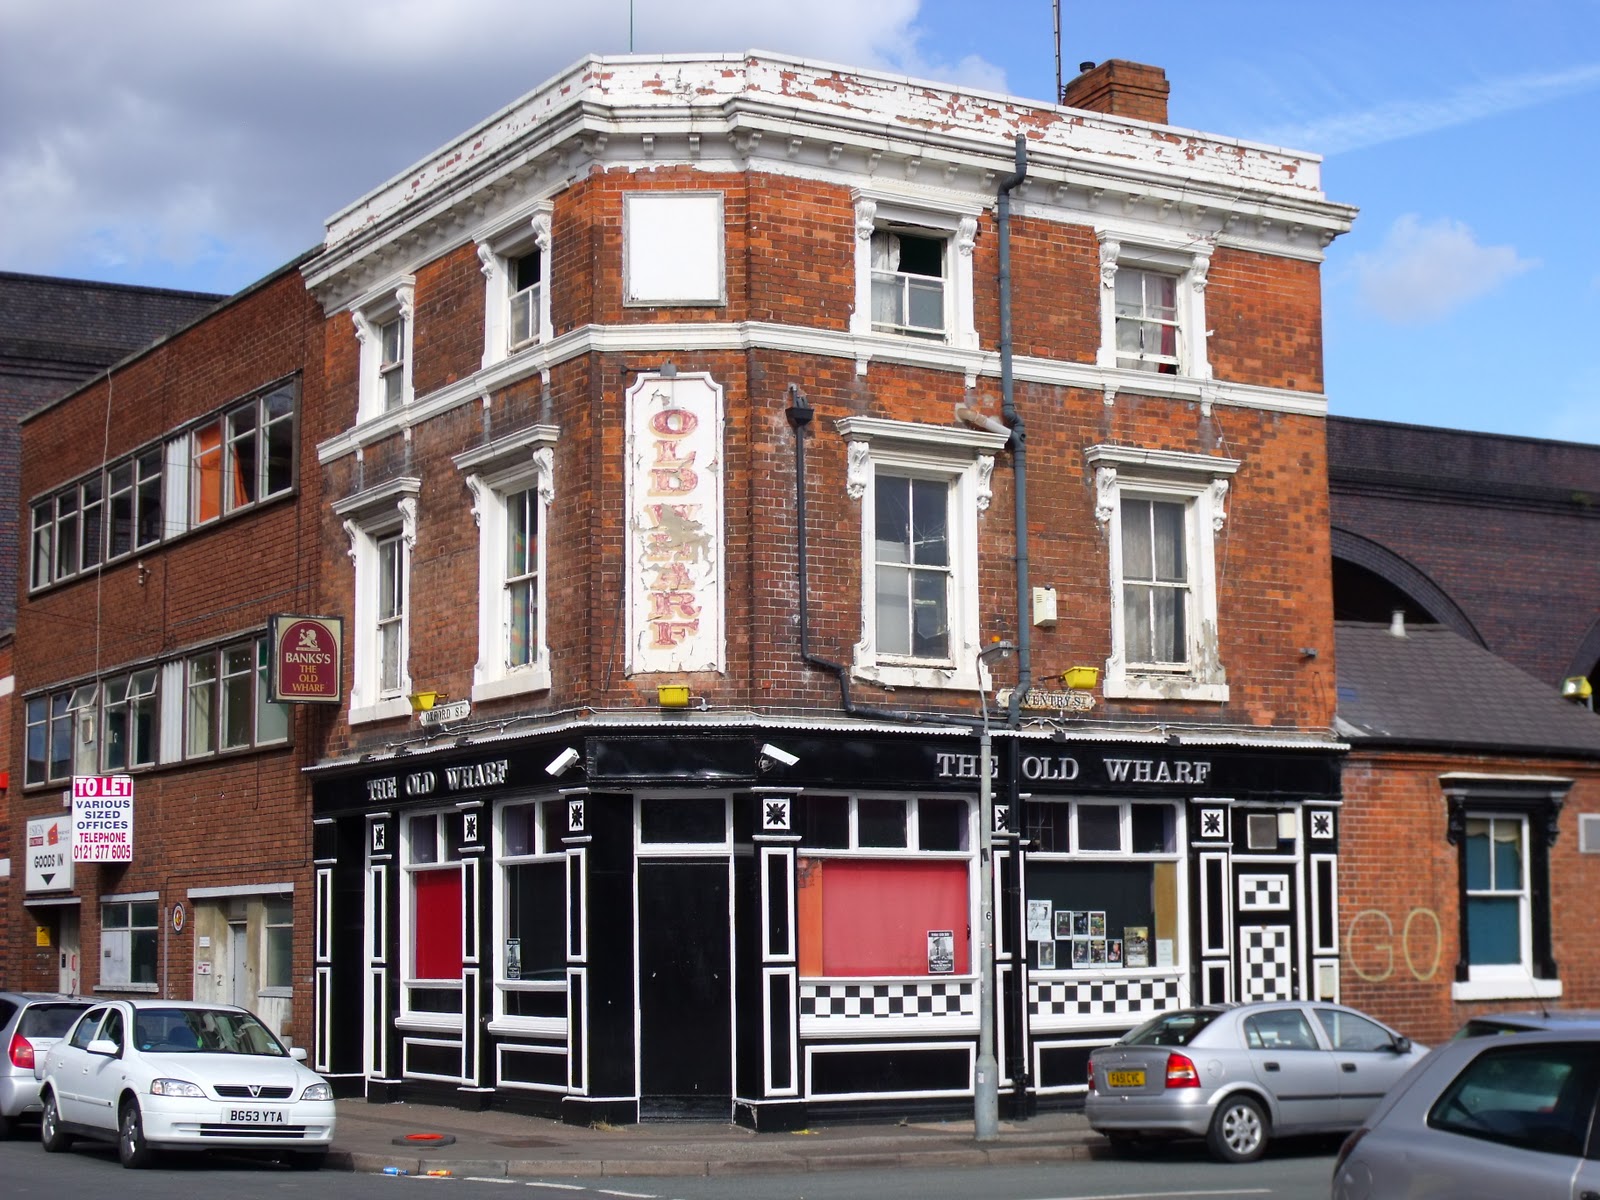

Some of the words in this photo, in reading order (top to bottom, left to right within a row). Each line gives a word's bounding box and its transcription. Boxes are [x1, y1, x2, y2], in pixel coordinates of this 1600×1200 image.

[648, 409, 698, 497] OLD
[285, 652, 332, 665] BANKS'S
[300, 665, 317, 674] THE
[299, 675, 318, 683] OLD
[292, 683, 325, 692] WHARF
[1009, 692, 1071, 707] VENTRY
[425, 708, 451, 722] OXFORD
[1022, 756, 1079, 780] OLD
[1103, 758, 1211, 784] WHARF
[367, 776, 397, 800] THE
[405, 771, 436, 796] OLD
[445, 759, 508, 790] WHARF
[76, 778, 98, 797] TO
[102, 777, 131, 796] LET
[76, 800, 130, 809] VARIOUS
[85, 811, 120, 819] SIZED
[77, 821, 128, 829] OFFICES
[79, 832, 126, 843] TELEPHONE
[74, 845, 92, 859] 0121
[95, 845, 109, 859] 377
[112, 844, 131, 859] 6005
[34, 854, 55, 868] GOODS
[57, 853, 64, 866] IN
[986, 911, 992, 921] 6
[1347, 907, 1443, 982] GO
[231, 1110, 259, 1121] BG53
[263, 1111, 283, 1122] YTA
